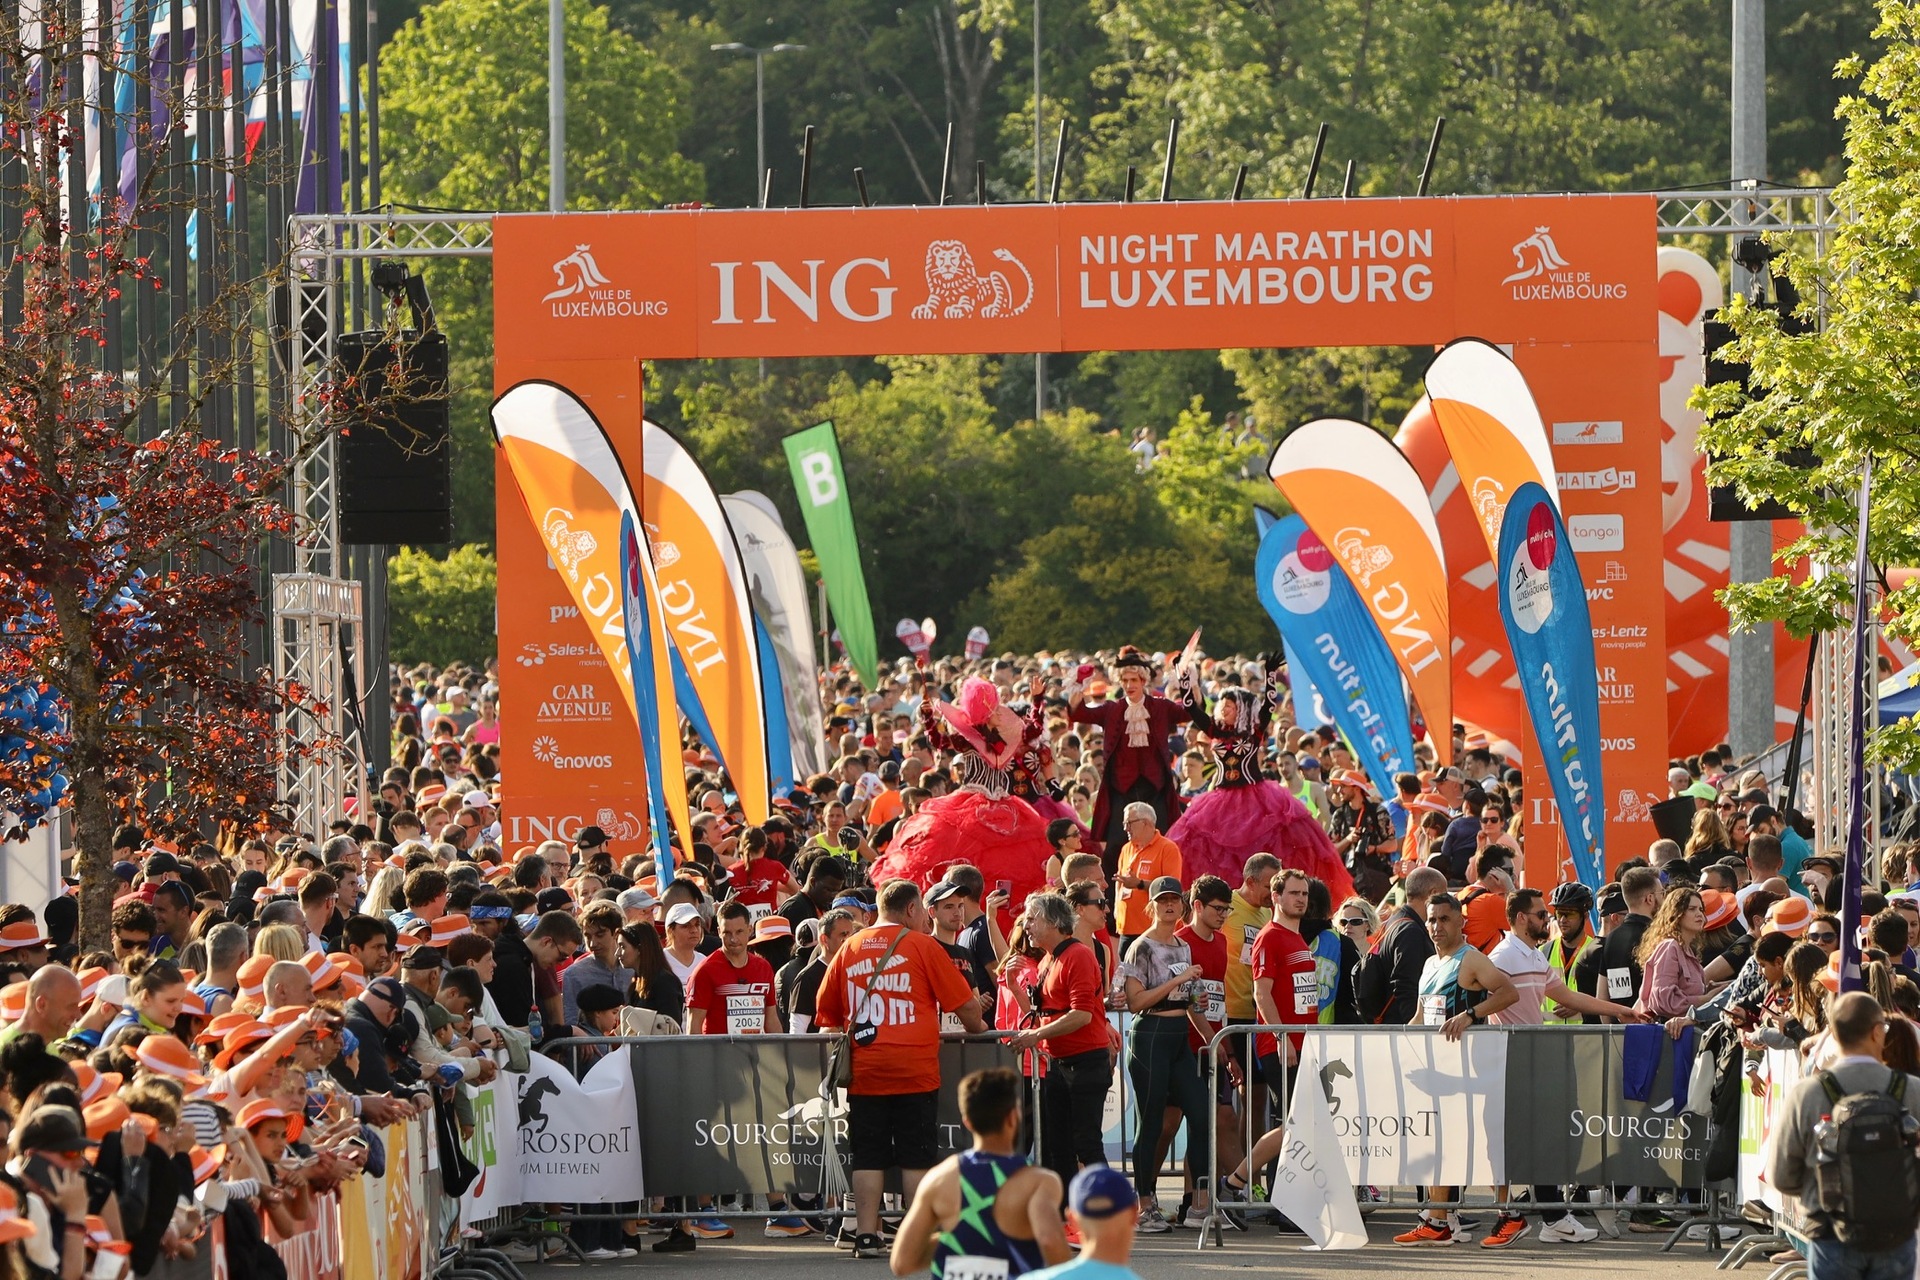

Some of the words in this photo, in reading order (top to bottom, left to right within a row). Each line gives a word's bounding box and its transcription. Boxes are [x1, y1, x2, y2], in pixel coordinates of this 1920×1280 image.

[1080, 233, 1199, 265] NIGHT
[1215, 228, 1433, 262] MARATHON
[1549, 272, 1574, 283] VILLE
[1578, 271, 1591, 282] DE
[710, 257, 898, 324] ING
[1080, 263, 1434, 308] LUXEMBOURG
[1512, 283, 1627, 301] LUXEMBOURG
[588, 289, 613, 300] VILLE
[616, 289, 632, 300] DE
[551, 300, 668, 318] LUXEMBOURG
[801, 451, 838, 507] B
[1584, 587, 1614, 600] wc
[550, 605, 579, 623] pw
[1591, 624, 1648, 638] es-Lentz
[548, 642, 602, 656] Sales-L
[552, 684, 595, 700] CAR
[1597, 684, 1635, 699] NUE
[537, 701, 612, 717] AVENUE
[1600, 738, 1636, 751] ovos
[553, 755, 612, 769] enovos
[1615, 976, 1630, 988] KM
[729, 998, 750, 1008] ING
[888, 997, 915, 1026] IT!
[735, 1018, 761, 1028] 200-2
[854, 1027, 876, 1040] CREW
[1332, 1110, 1438, 1137] OSPORT
[1569, 1109, 1692, 1141] SOURCES
[694, 1118, 821, 1147] SOURCES
[521, 1126, 632, 1155] ROSPORT
[1643, 1146, 1701, 1161] SOURCE
[546, 1162, 600, 1175] LIEWEN
